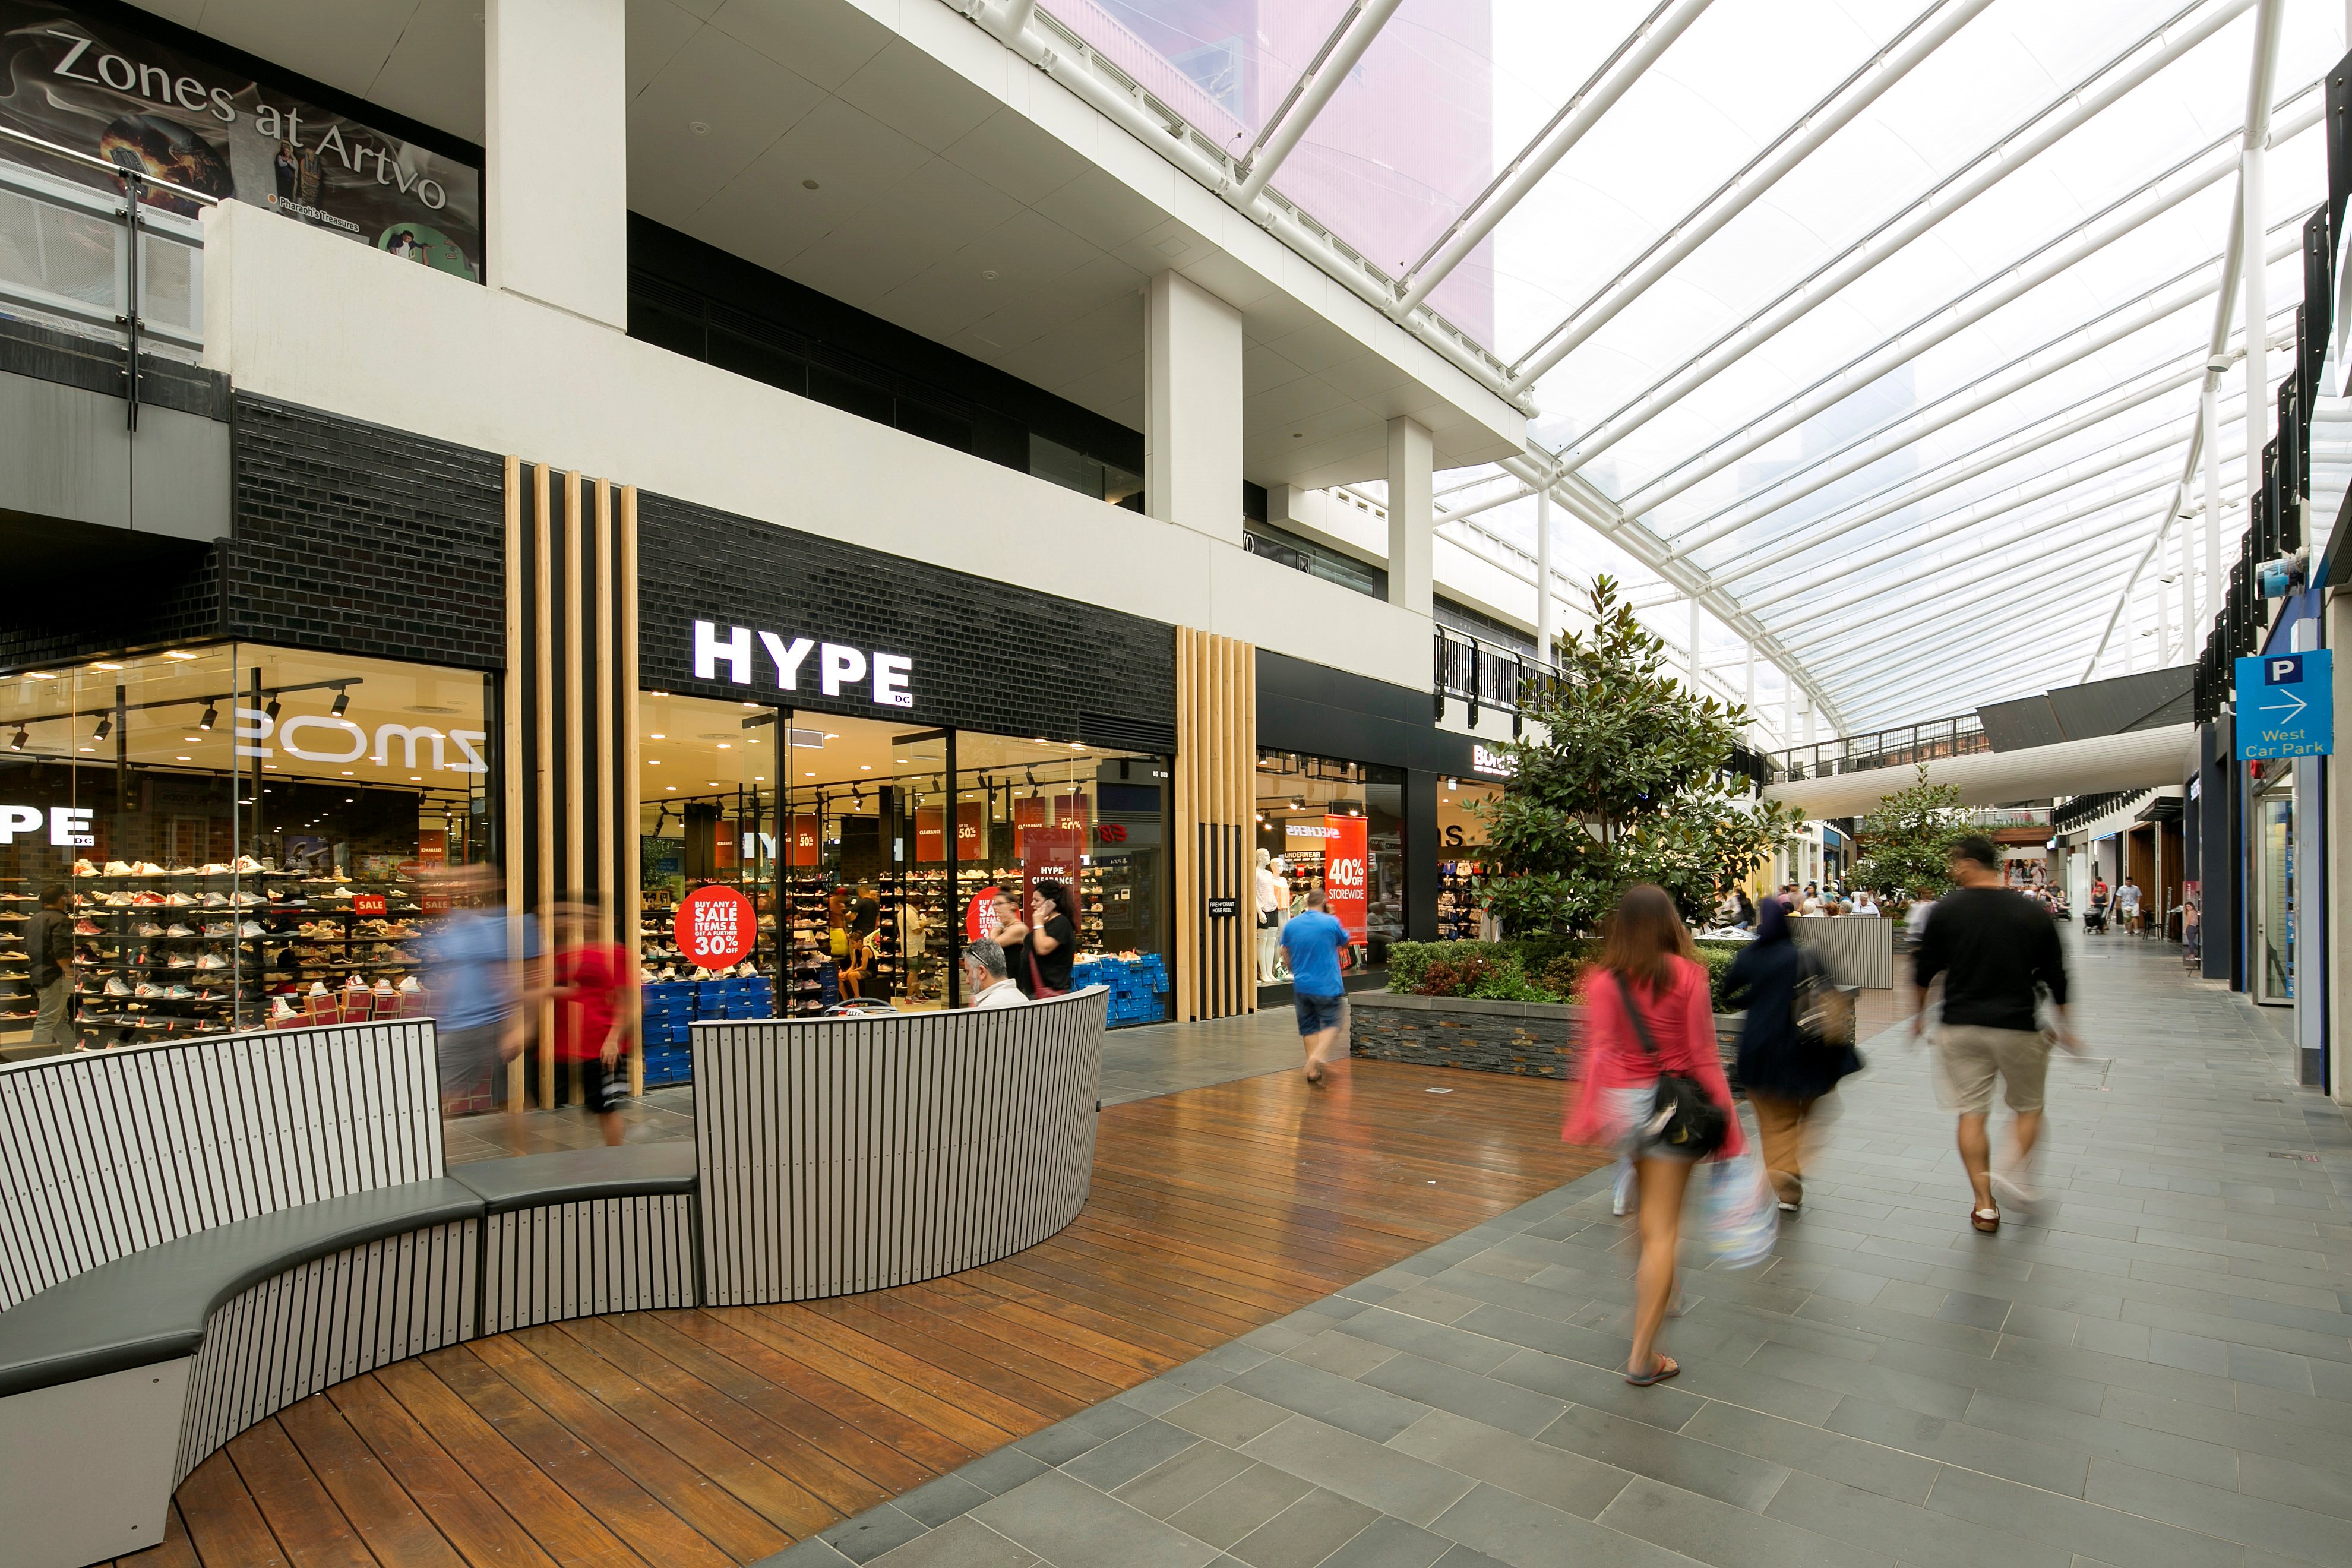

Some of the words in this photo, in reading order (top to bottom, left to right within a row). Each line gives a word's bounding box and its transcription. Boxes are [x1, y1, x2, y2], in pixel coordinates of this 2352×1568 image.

[46, 29, 235, 122] Zones
[255, 104, 304, 147] at
[316, 125, 446, 210] Artvo
[280, 197, 320, 219] Pharaoh's
[321, 211, 359, 232] Treasures
[694, 620, 913, 707] HYPE
[894, 695, 910, 704] DC
[2272, 660, 2294, 681] P
[2262, 729, 2305, 742] West
[2246, 745, 2276, 757] Car
[2283, 742, 2324, 755] Park
[959, 827, 976, 839] 50%
[800, 837, 814, 846] 50%
[1329, 858, 1364, 886] 40%
[1352, 877, 1364, 886] OFF
[1329, 889, 1364, 900] STOREWIDE
[359, 901, 383, 909] SALE
[425, 901, 447, 909] SALE
[979, 905, 997, 917] SA
[694, 908, 738, 922] SALE
[694, 922, 726, 931] ITEMS
[729, 922, 737, 930] &
[694, 935, 738, 955] 30%
